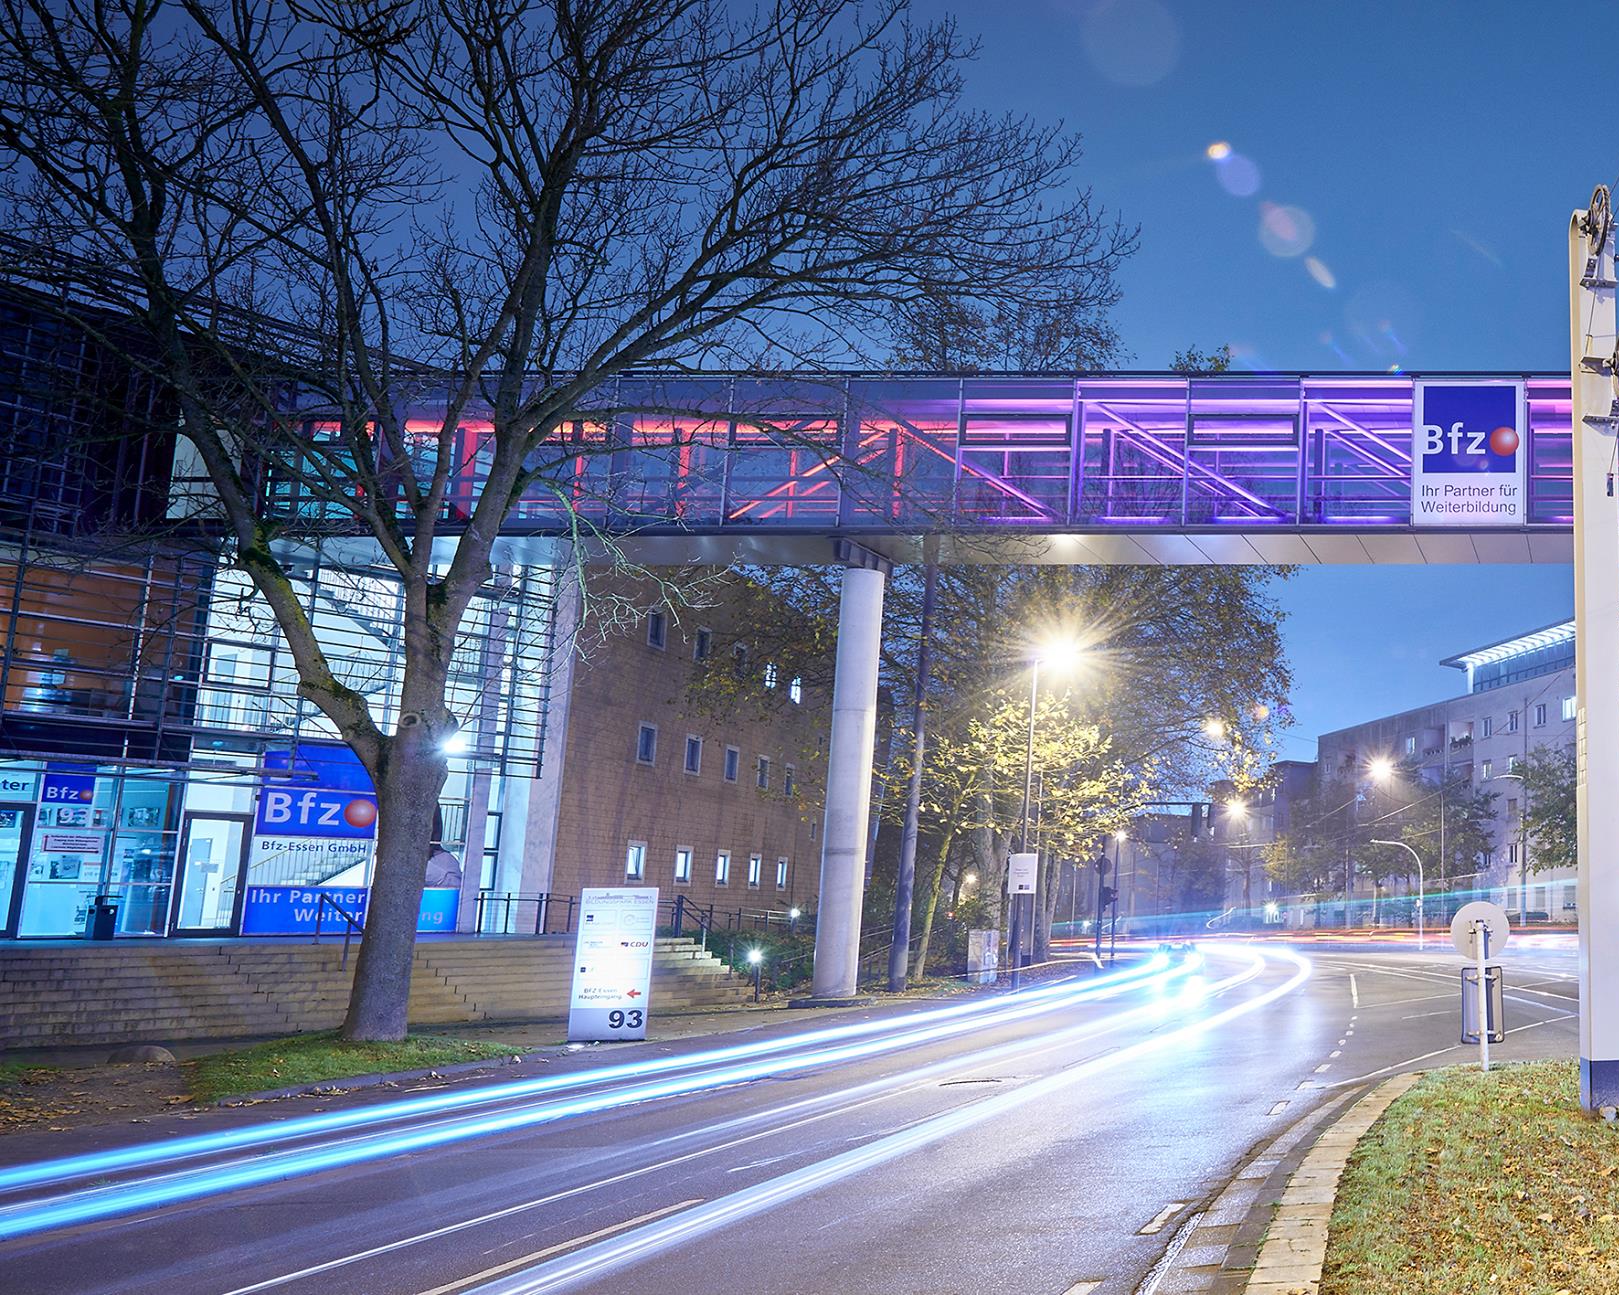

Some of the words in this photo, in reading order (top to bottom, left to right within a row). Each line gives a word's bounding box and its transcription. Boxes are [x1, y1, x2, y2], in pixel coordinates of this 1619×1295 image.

[1423, 422, 1486, 455] Bfz
[1422, 485, 1440, 496] Ihr
[1444, 485, 1495, 496] Partner
[1499, 484, 1518, 496] für
[1421, 501, 1517, 515] Weiterbildung
[46, 786, 79, 800] Bfz
[264, 792, 341, 826] Bfz
[261, 840, 324, 852] Bfz-Essen
[328, 843, 367, 853] GmbH
[251, 889, 281, 904] Ihr
[608, 1010, 643, 1029] 93
